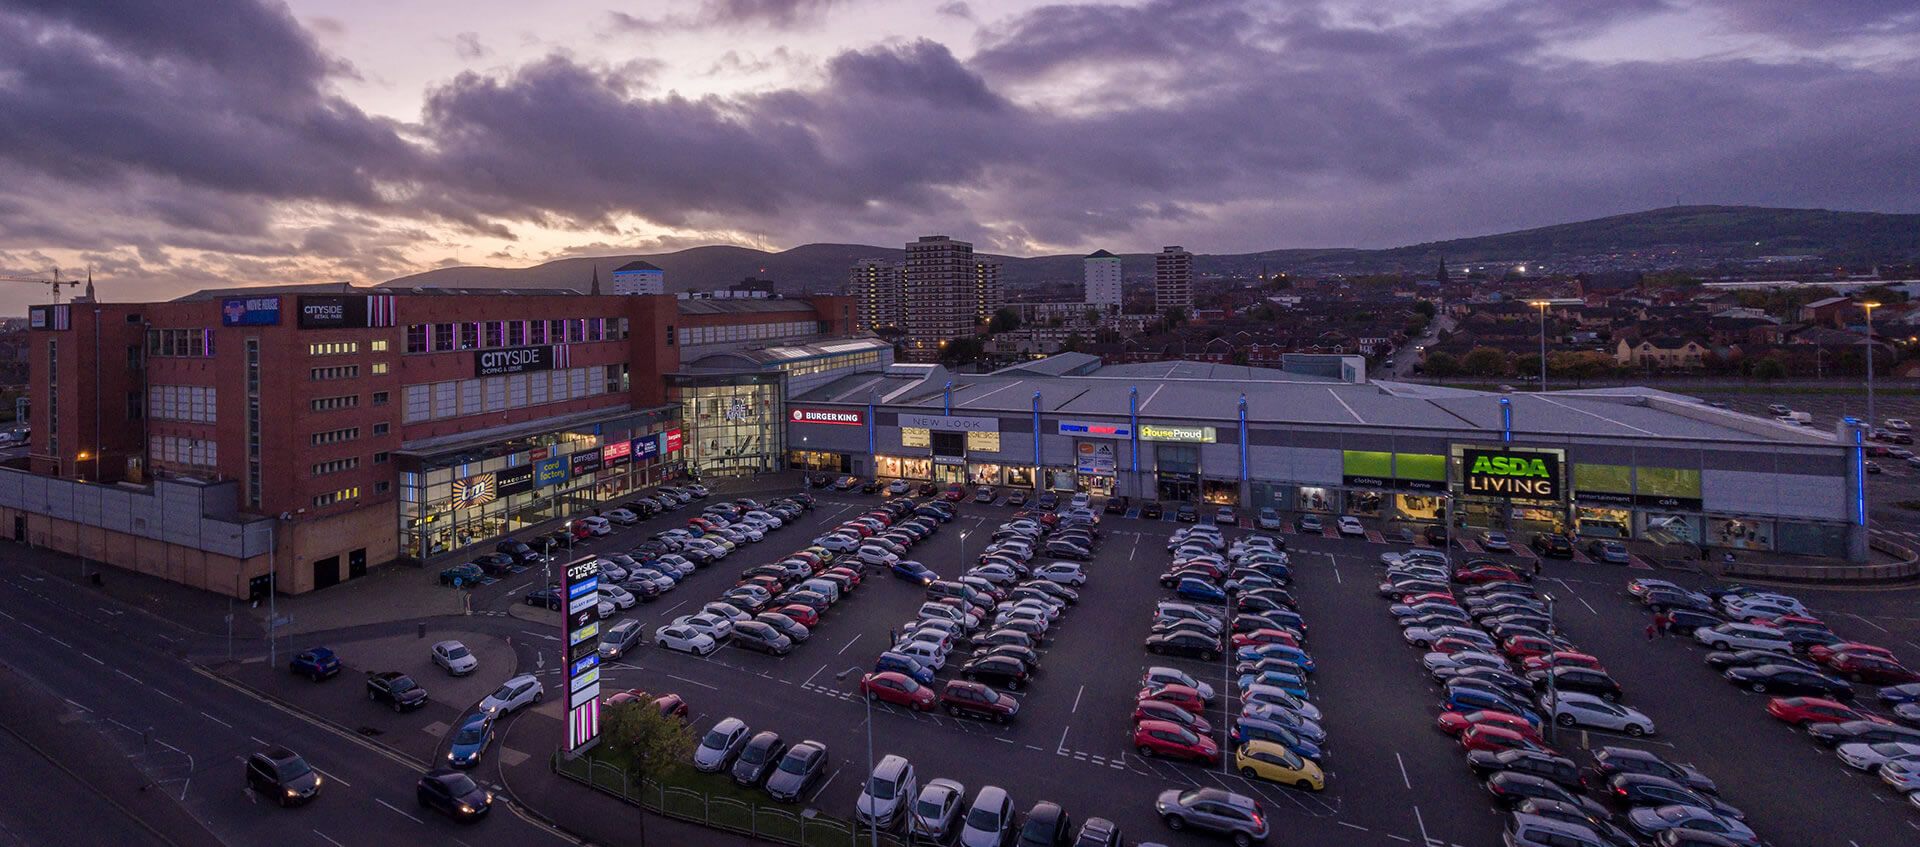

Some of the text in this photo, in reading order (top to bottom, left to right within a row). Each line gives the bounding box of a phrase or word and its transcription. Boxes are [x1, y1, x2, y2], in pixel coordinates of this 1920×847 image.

[304, 305, 343, 314] CITYSIDE
[481, 348, 540, 368] CITYSIDE
[806, 411, 858, 422] BURGER KING
[913, 417, 981, 428] NEW LOOK
[544, 460, 560, 471] card
[1471, 455, 1550, 478] ASDA
[540, 469, 565, 481] factory
[1354, 477, 1382, 486] clothing
[1471, 476, 1551, 495] LIVING
[567, 560, 598, 578] CTYSIDE
